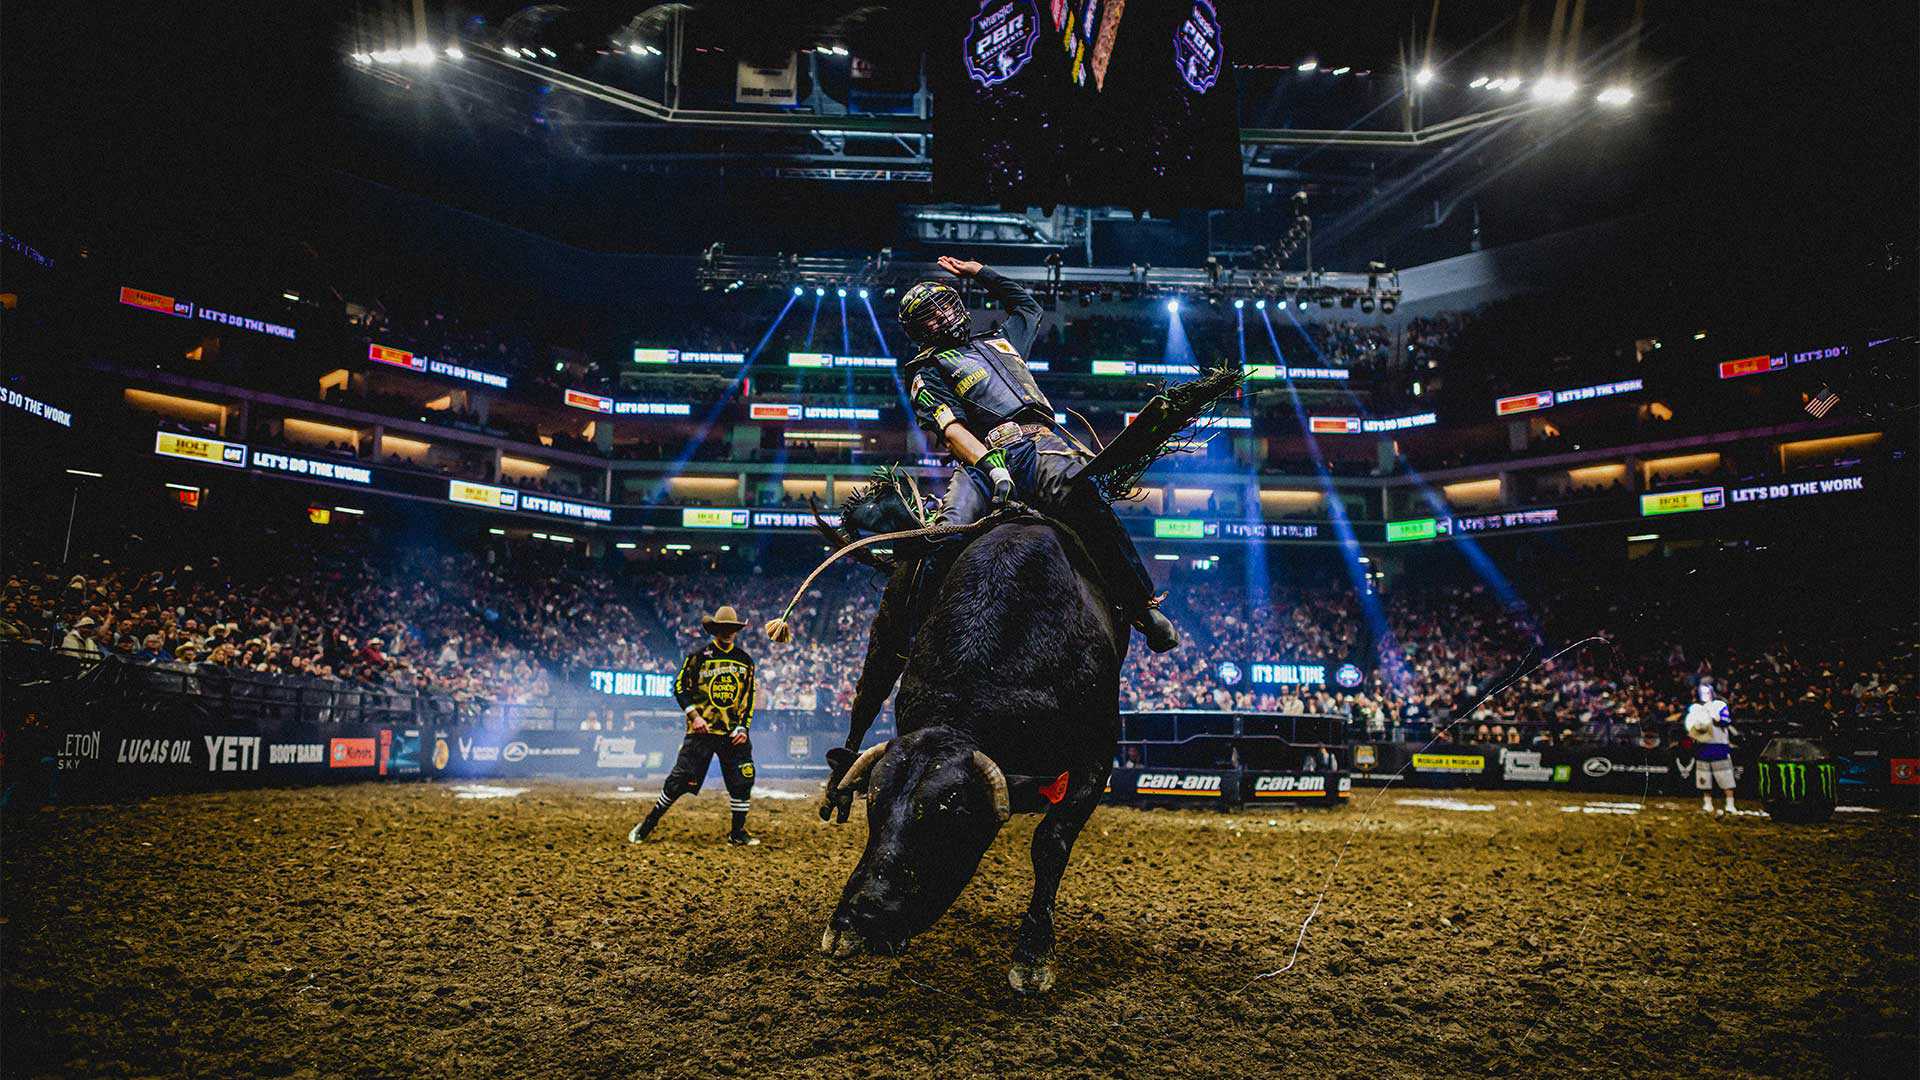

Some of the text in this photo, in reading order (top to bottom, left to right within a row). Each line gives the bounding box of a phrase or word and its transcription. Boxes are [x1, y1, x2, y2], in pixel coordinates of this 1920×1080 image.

[976, 13, 1025, 57] PBR
[1184, 19, 1216, 62] PBR
[199, 308, 297, 339] LET'S DO THE WORK
[1794, 349, 1823, 364] LET'S
[1824, 347, 1841, 358] DO
[8, 390, 23, 407] DO
[24, 397, 44, 416] THE
[44, 404, 72, 427] WORK
[253, 452, 371, 483] LET'S DO THE WORK
[1732, 476, 1863, 502] LET'S DO THE WORK
[522, 496, 549, 513] LET'S
[754, 513, 782, 526] LET'S
[590, 671, 674, 697] IT'S BULL TIME
[1251, 664, 1325, 684] IT'S BULL TIME
[117, 739, 192, 764] LUCAS OIL
[204, 735, 262, 772] YETI
[269, 744, 324, 764] BOOT BARN
[57, 759, 81, 770] SKY
[1137, 773, 1222, 790] can-am
[1254, 776, 1325, 791] can-am
